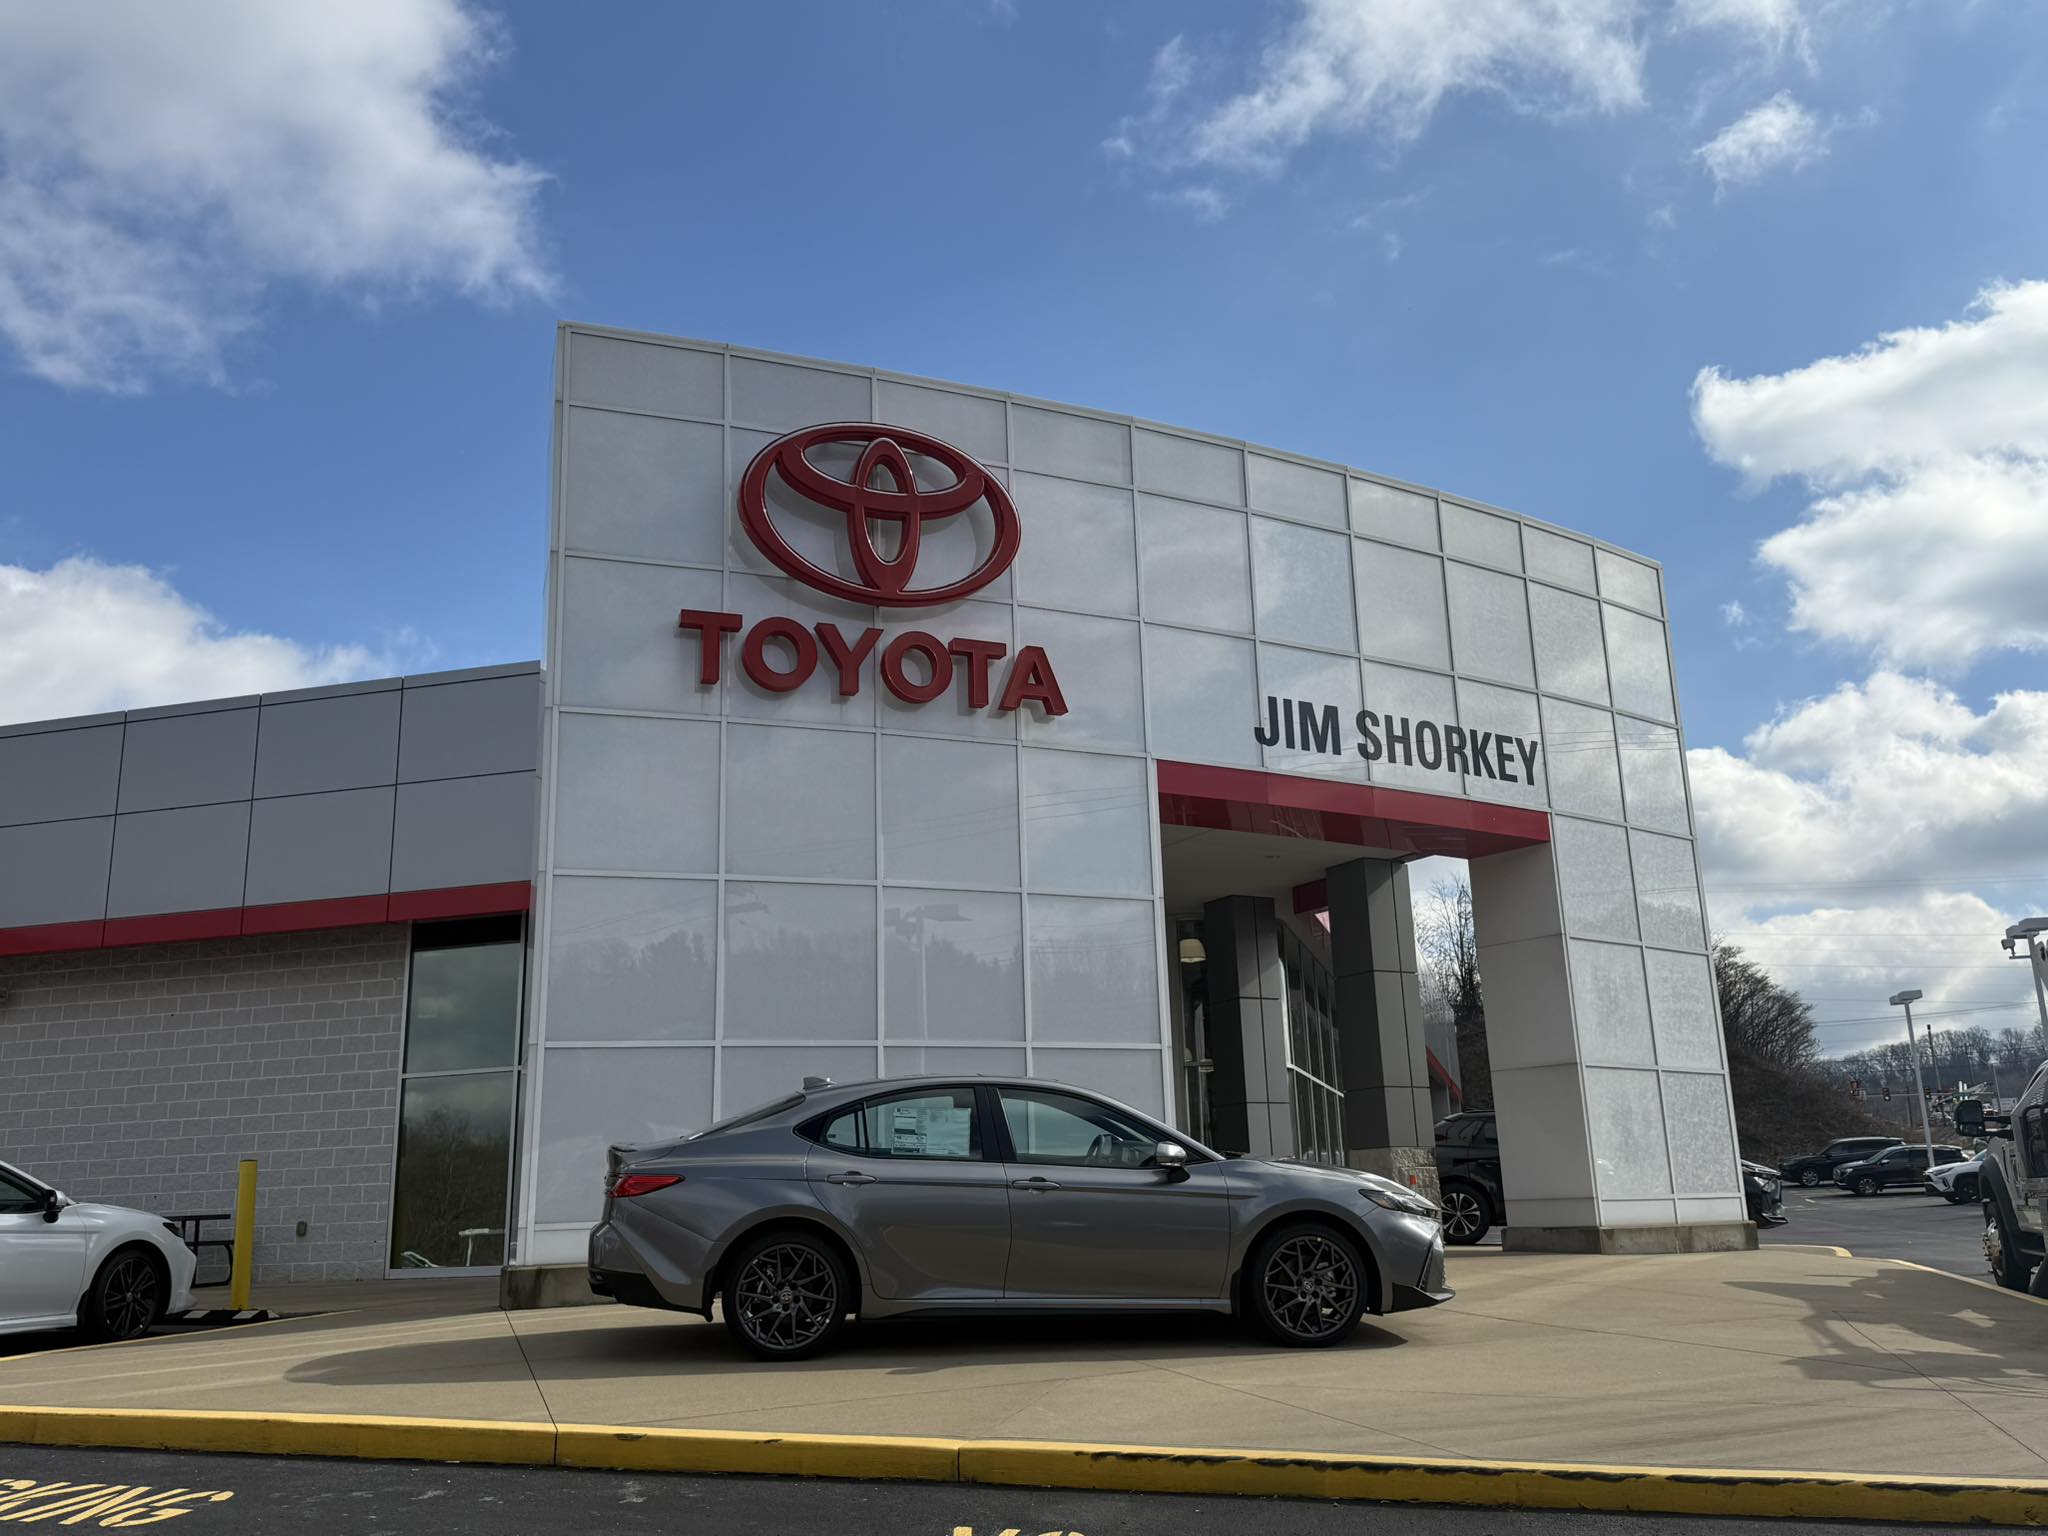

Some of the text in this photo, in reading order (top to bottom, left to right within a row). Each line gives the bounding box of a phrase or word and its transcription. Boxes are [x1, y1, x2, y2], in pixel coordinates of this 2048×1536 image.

[679, 609, 1069, 716] TOYOTA
[1254, 696, 1539, 786] JIM SHORKEY
